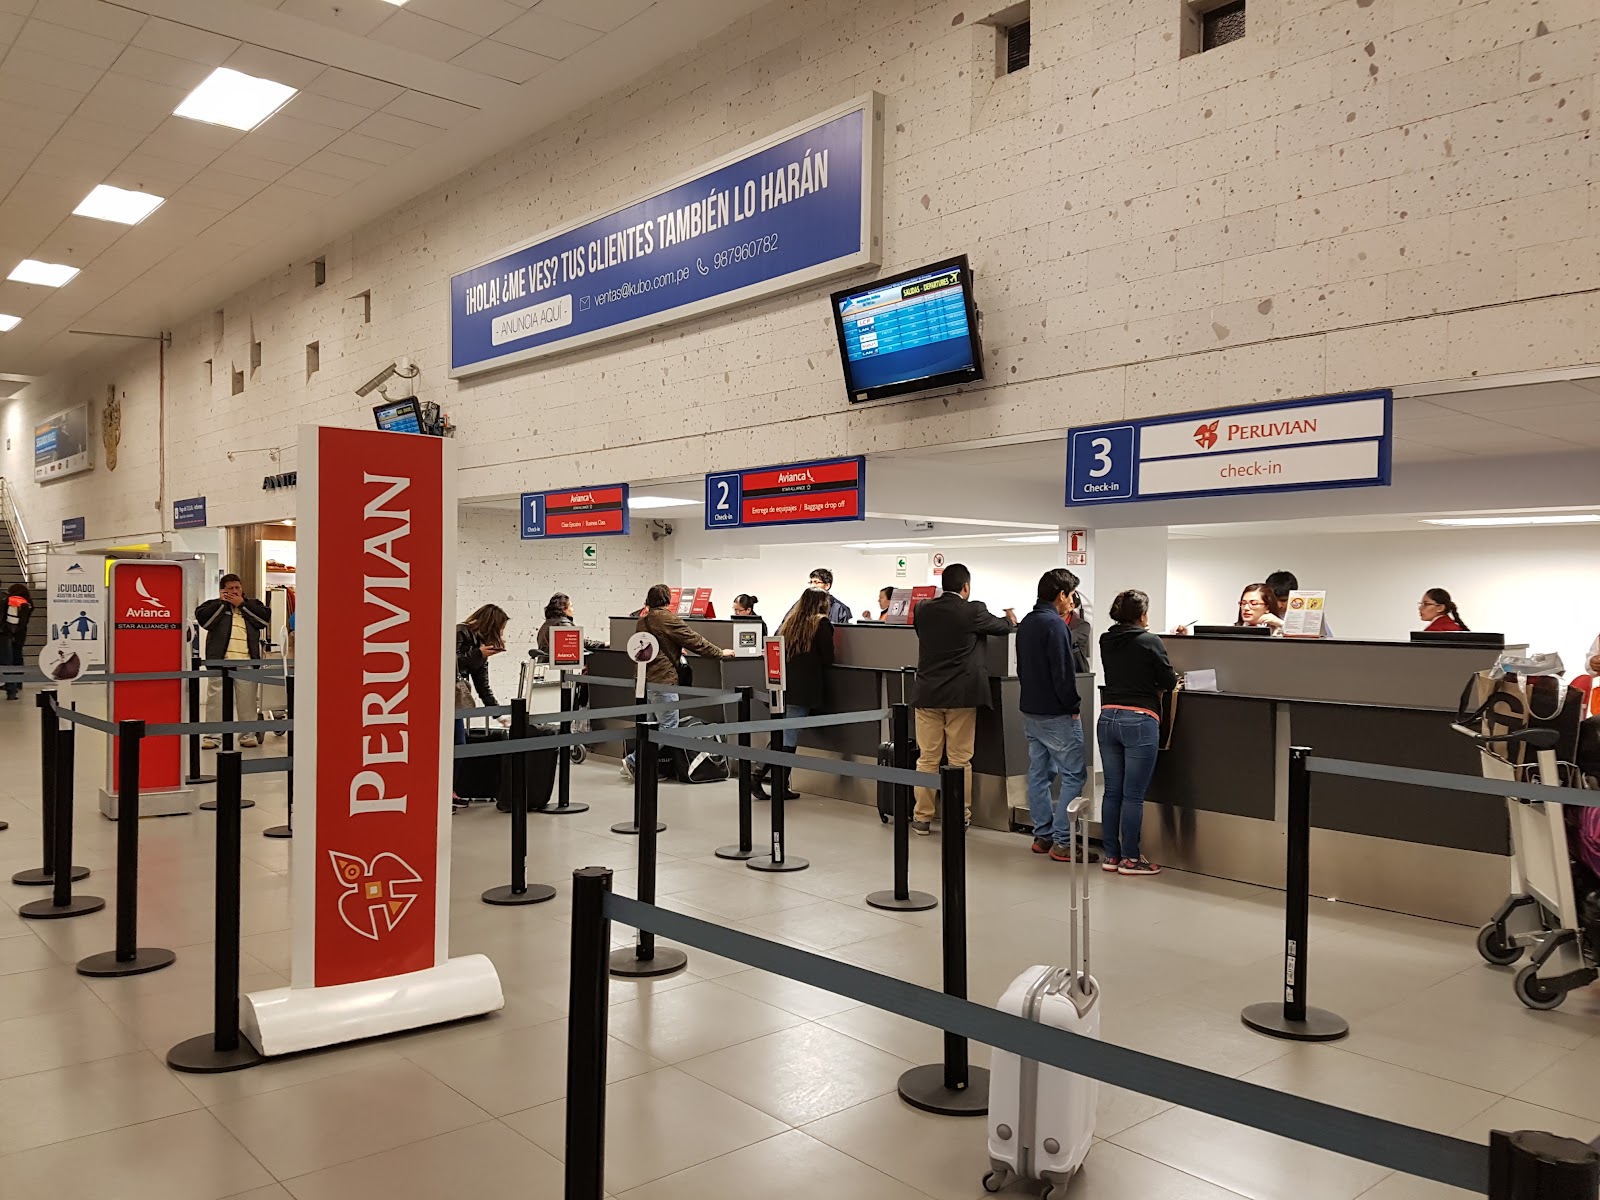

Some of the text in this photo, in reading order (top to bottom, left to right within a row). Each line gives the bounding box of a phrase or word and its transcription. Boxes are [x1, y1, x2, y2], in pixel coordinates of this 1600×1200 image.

[466, 148, 829, 316] ¡HOLA! ¿ME VES? TUS CLIENTES TAMBIÉN LO HARÁN
[594, 233, 779, 306] ventas@kubo.com.pe 987960782
[500, 308, 539, 336] ANUNCIA
[540, 300, 563, 326] AQUÍ
[1227, 418, 1318, 441] PERUVIAN
[1089, 437, 1112, 478] 3
[1220, 460, 1282, 478] check-in
[778, 470, 807, 484] Avianca
[1083, 481, 1120, 493] Check-in
[716, 480, 730, 510] 2
[530, 500, 537, 524] 1
[714, 513, 733, 521] Check-in
[751, 506, 769, 516] Entrega
[776, 504, 798, 515] equipajes
[803, 502, 824, 512] Baggage
[824, 501, 837, 511] drop
[837, 499, 846, 508] off
[126, 607, 171, 618] Avianca
[349, 470, 411, 818] PERUVIAN
